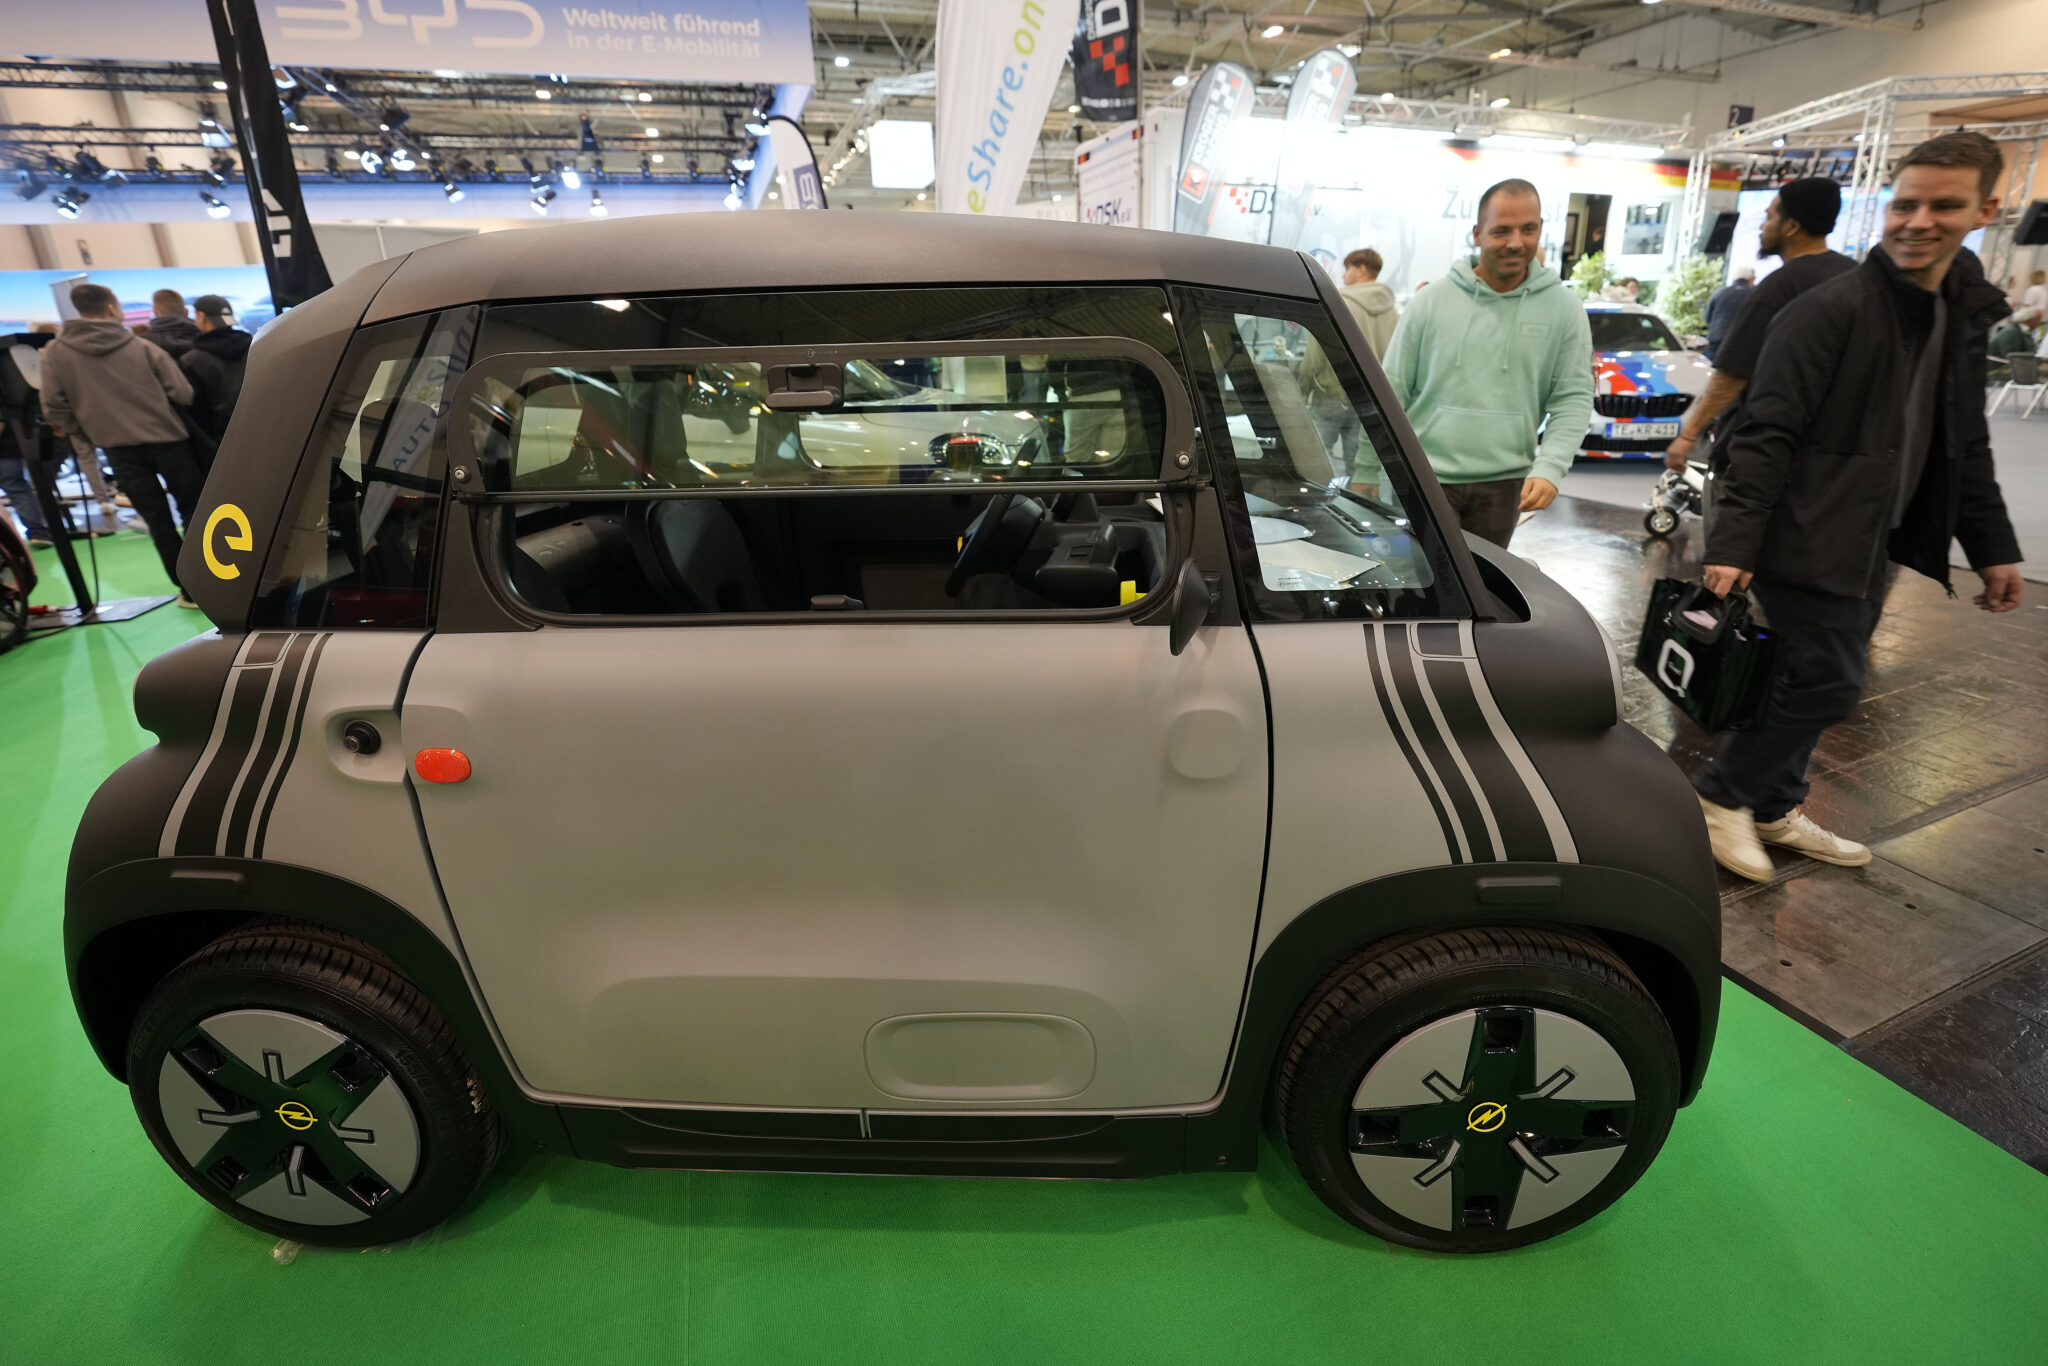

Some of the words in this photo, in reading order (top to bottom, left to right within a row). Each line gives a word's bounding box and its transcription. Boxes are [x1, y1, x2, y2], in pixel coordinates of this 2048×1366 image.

[561, 7, 668, 31] Weltweit
[674, 13, 760, 37] führend
[566, 30, 590, 49] in
[599, 32, 634, 52] der
[641, 34, 762, 58] E-Mobilität
[967, 0, 1047, 213] eShare.on
